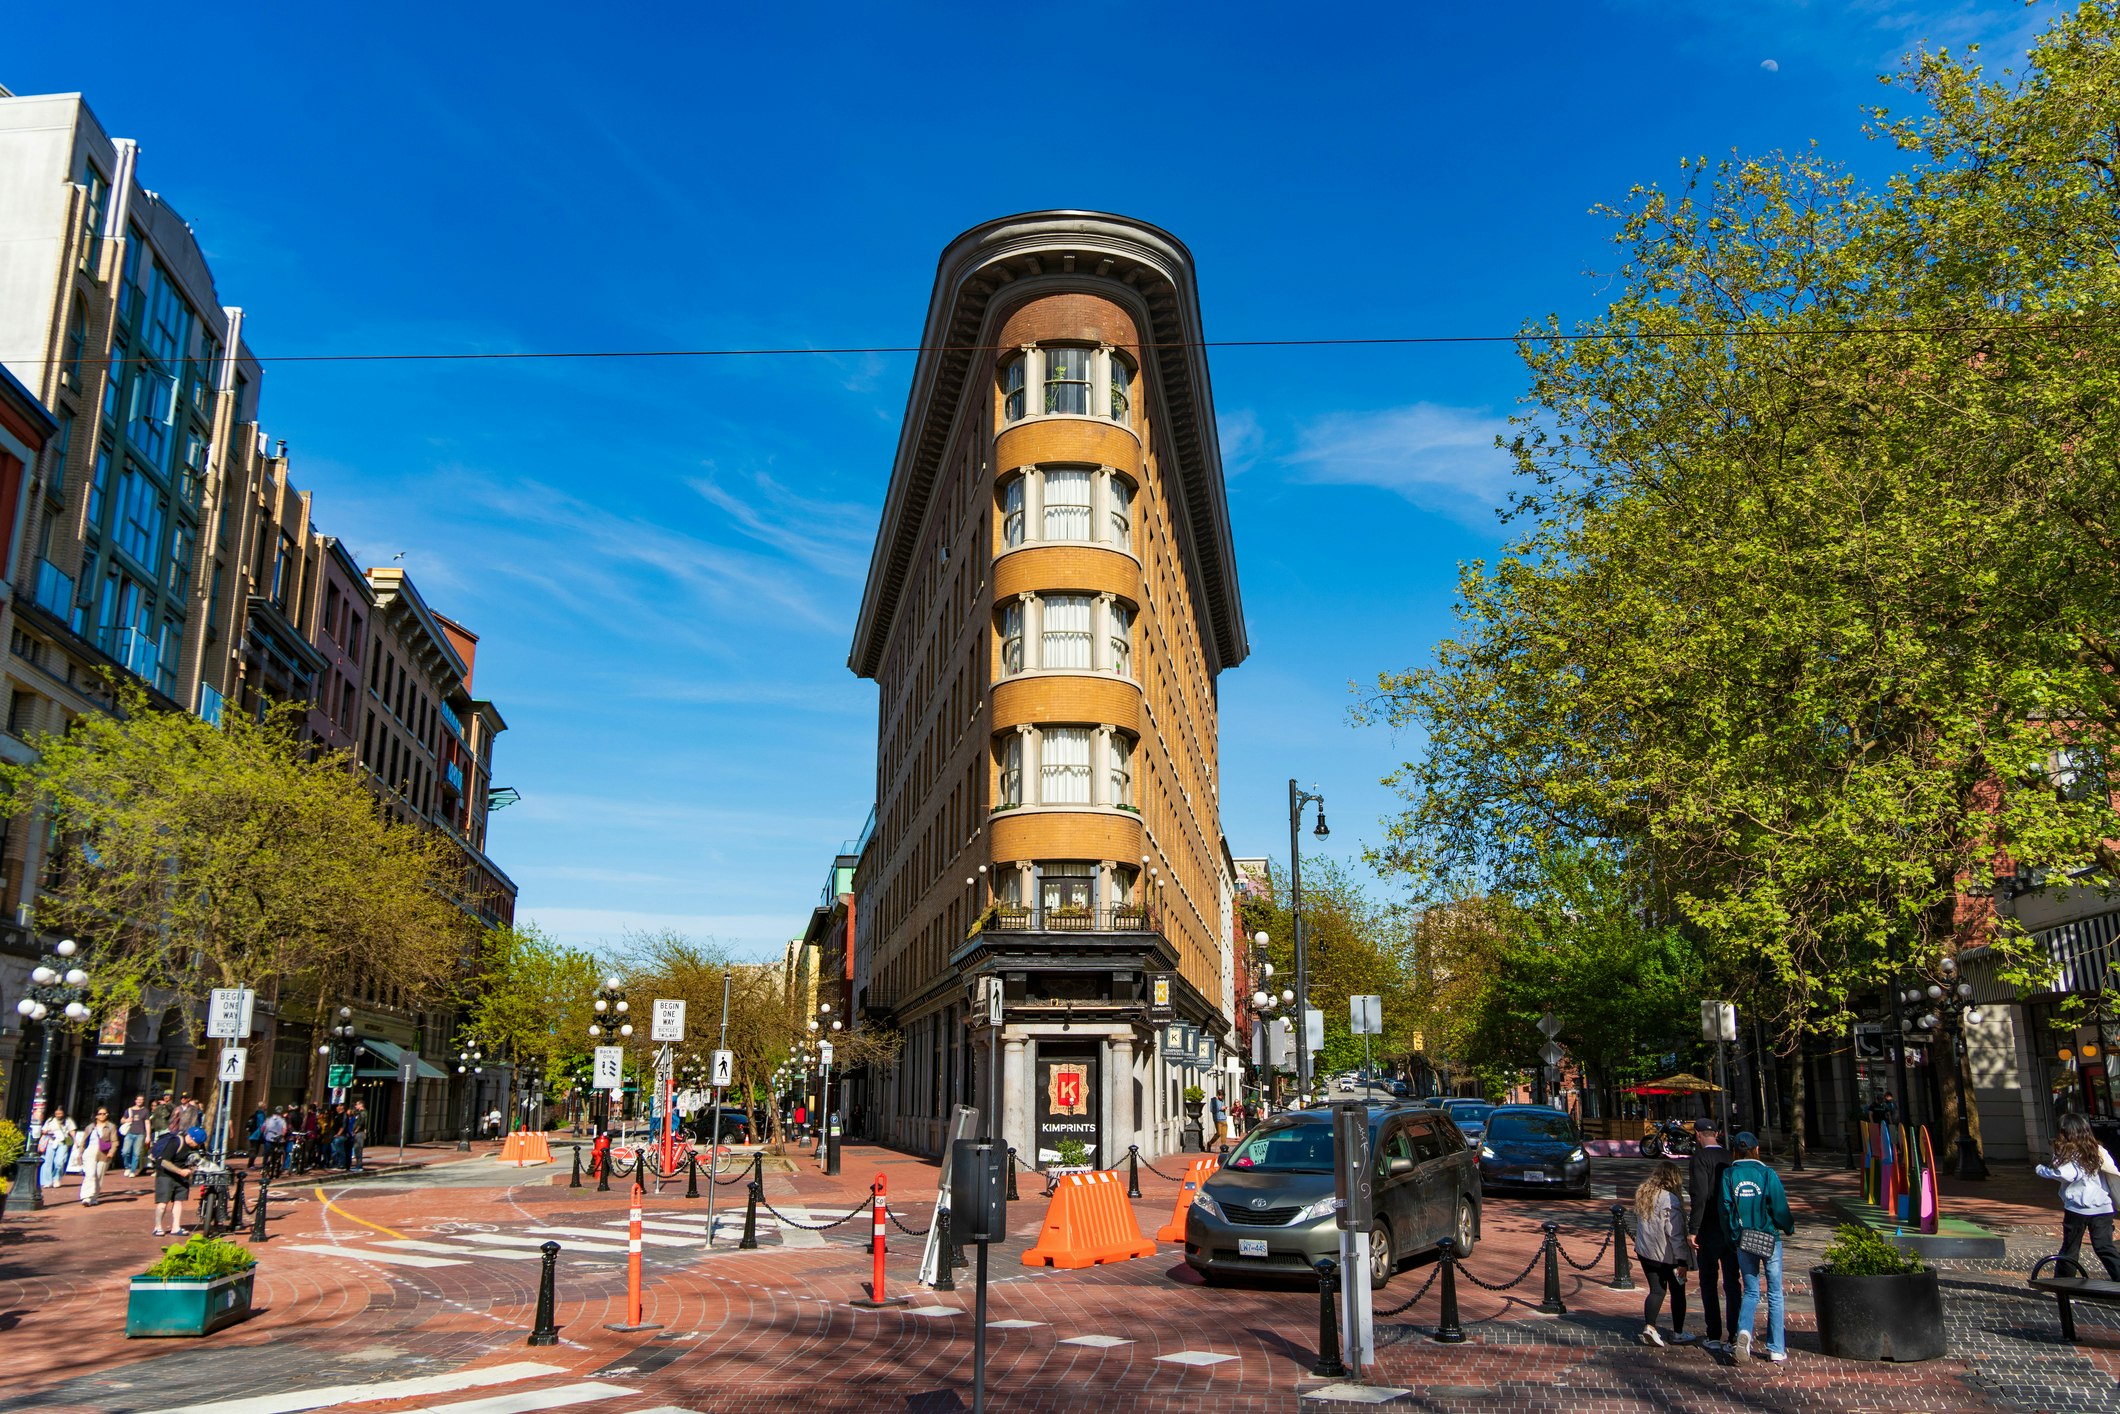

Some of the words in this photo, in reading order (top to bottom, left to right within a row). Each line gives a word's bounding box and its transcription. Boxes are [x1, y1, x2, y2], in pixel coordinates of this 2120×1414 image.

[1158, 988, 1165, 998] K
[660, 1002, 680, 1010] BEGIN
[662, 1010, 676, 1018] ONE
[1171, 1034, 1178, 1042] K
[1061, 1081, 1077, 1099] K
[1042, 1123, 1096, 1132] KIMPRINTS
